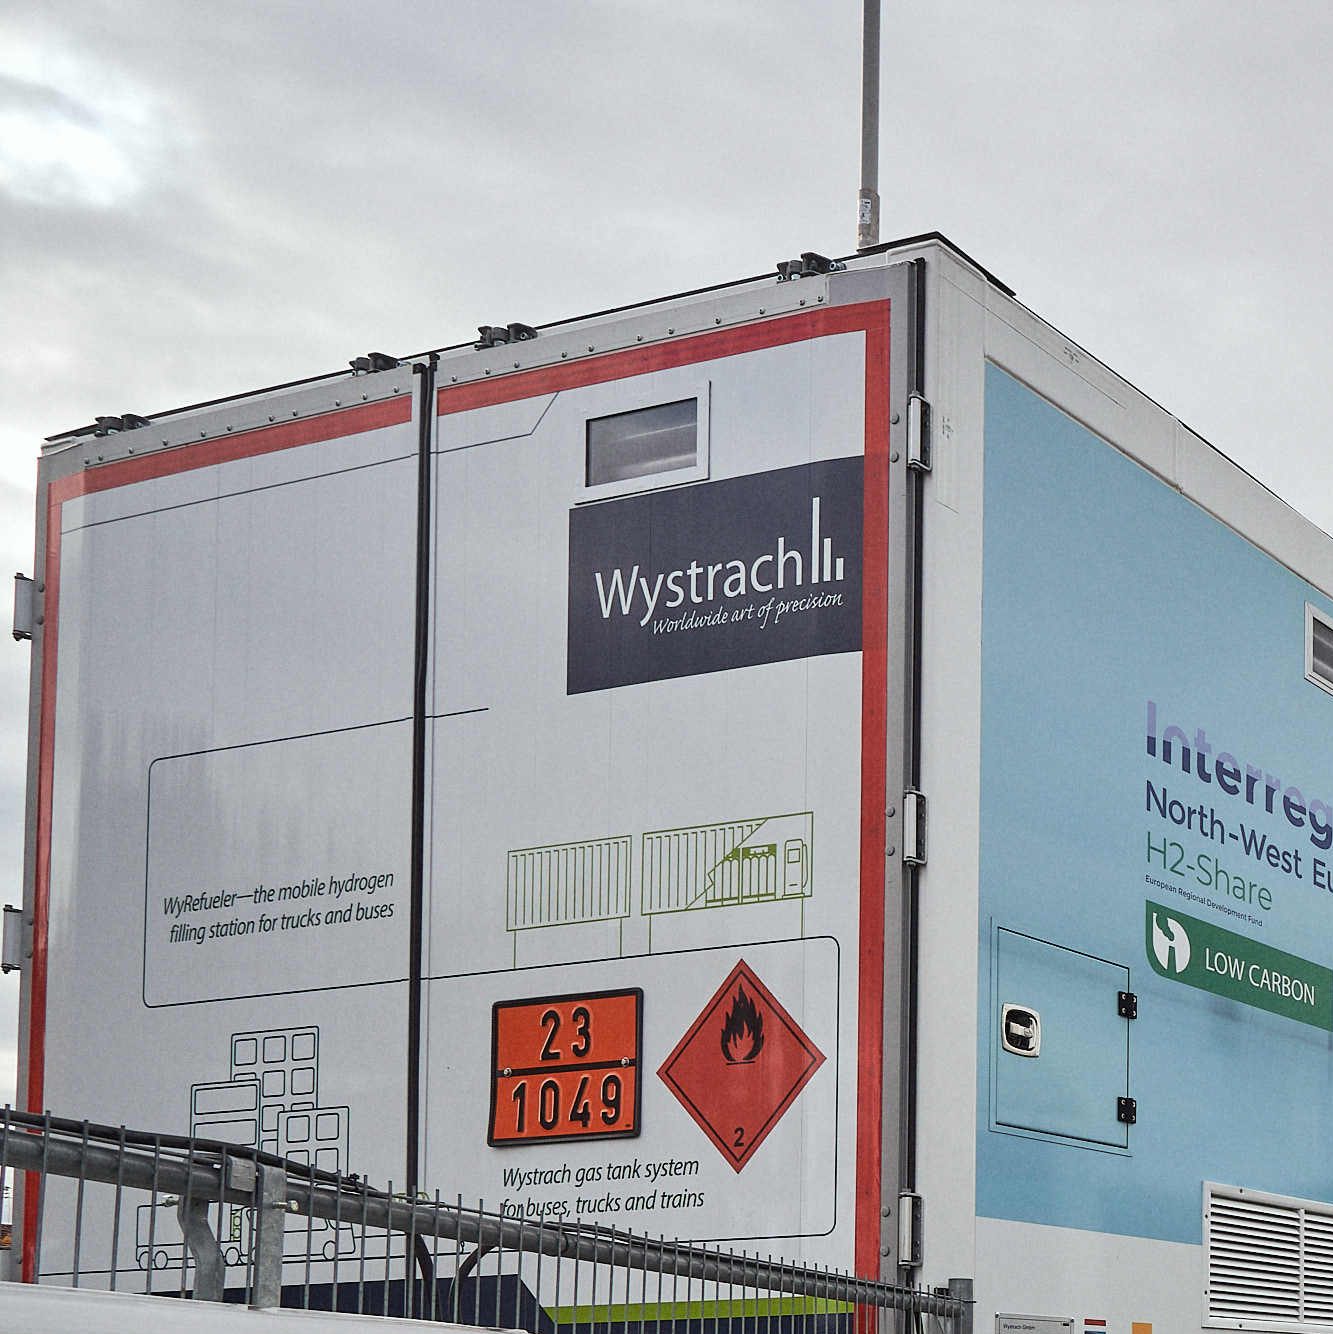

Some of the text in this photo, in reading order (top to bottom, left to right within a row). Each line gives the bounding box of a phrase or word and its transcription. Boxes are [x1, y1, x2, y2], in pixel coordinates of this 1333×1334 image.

[595, 537, 802, 626] Wystrach
[653, 592, 843, 634] Worldwide art of precision
[1147, 700, 1333, 850] Interreg
[1146, 780, 1303, 879] North-West
[278, 878, 326, 901] mobile
[328, 872, 394, 898] hydrogen
[1147, 831, 1273, 911] H2-Share
[169, 902, 395, 945] filling station for trucks and buses
[1145, 874, 1263, 927] European Regional Development Fund
[1205, 947, 1315, 1006] LOW CARBON
[539, 1006, 592, 1061] 23
[511, 1074, 623, 1133] 1049
[733, 1127, 745, 1147] 2
[502, 1159, 699, 1191] Wystrach gas tank system
[502, 1188, 705, 1218] for buses, trucks and trains
